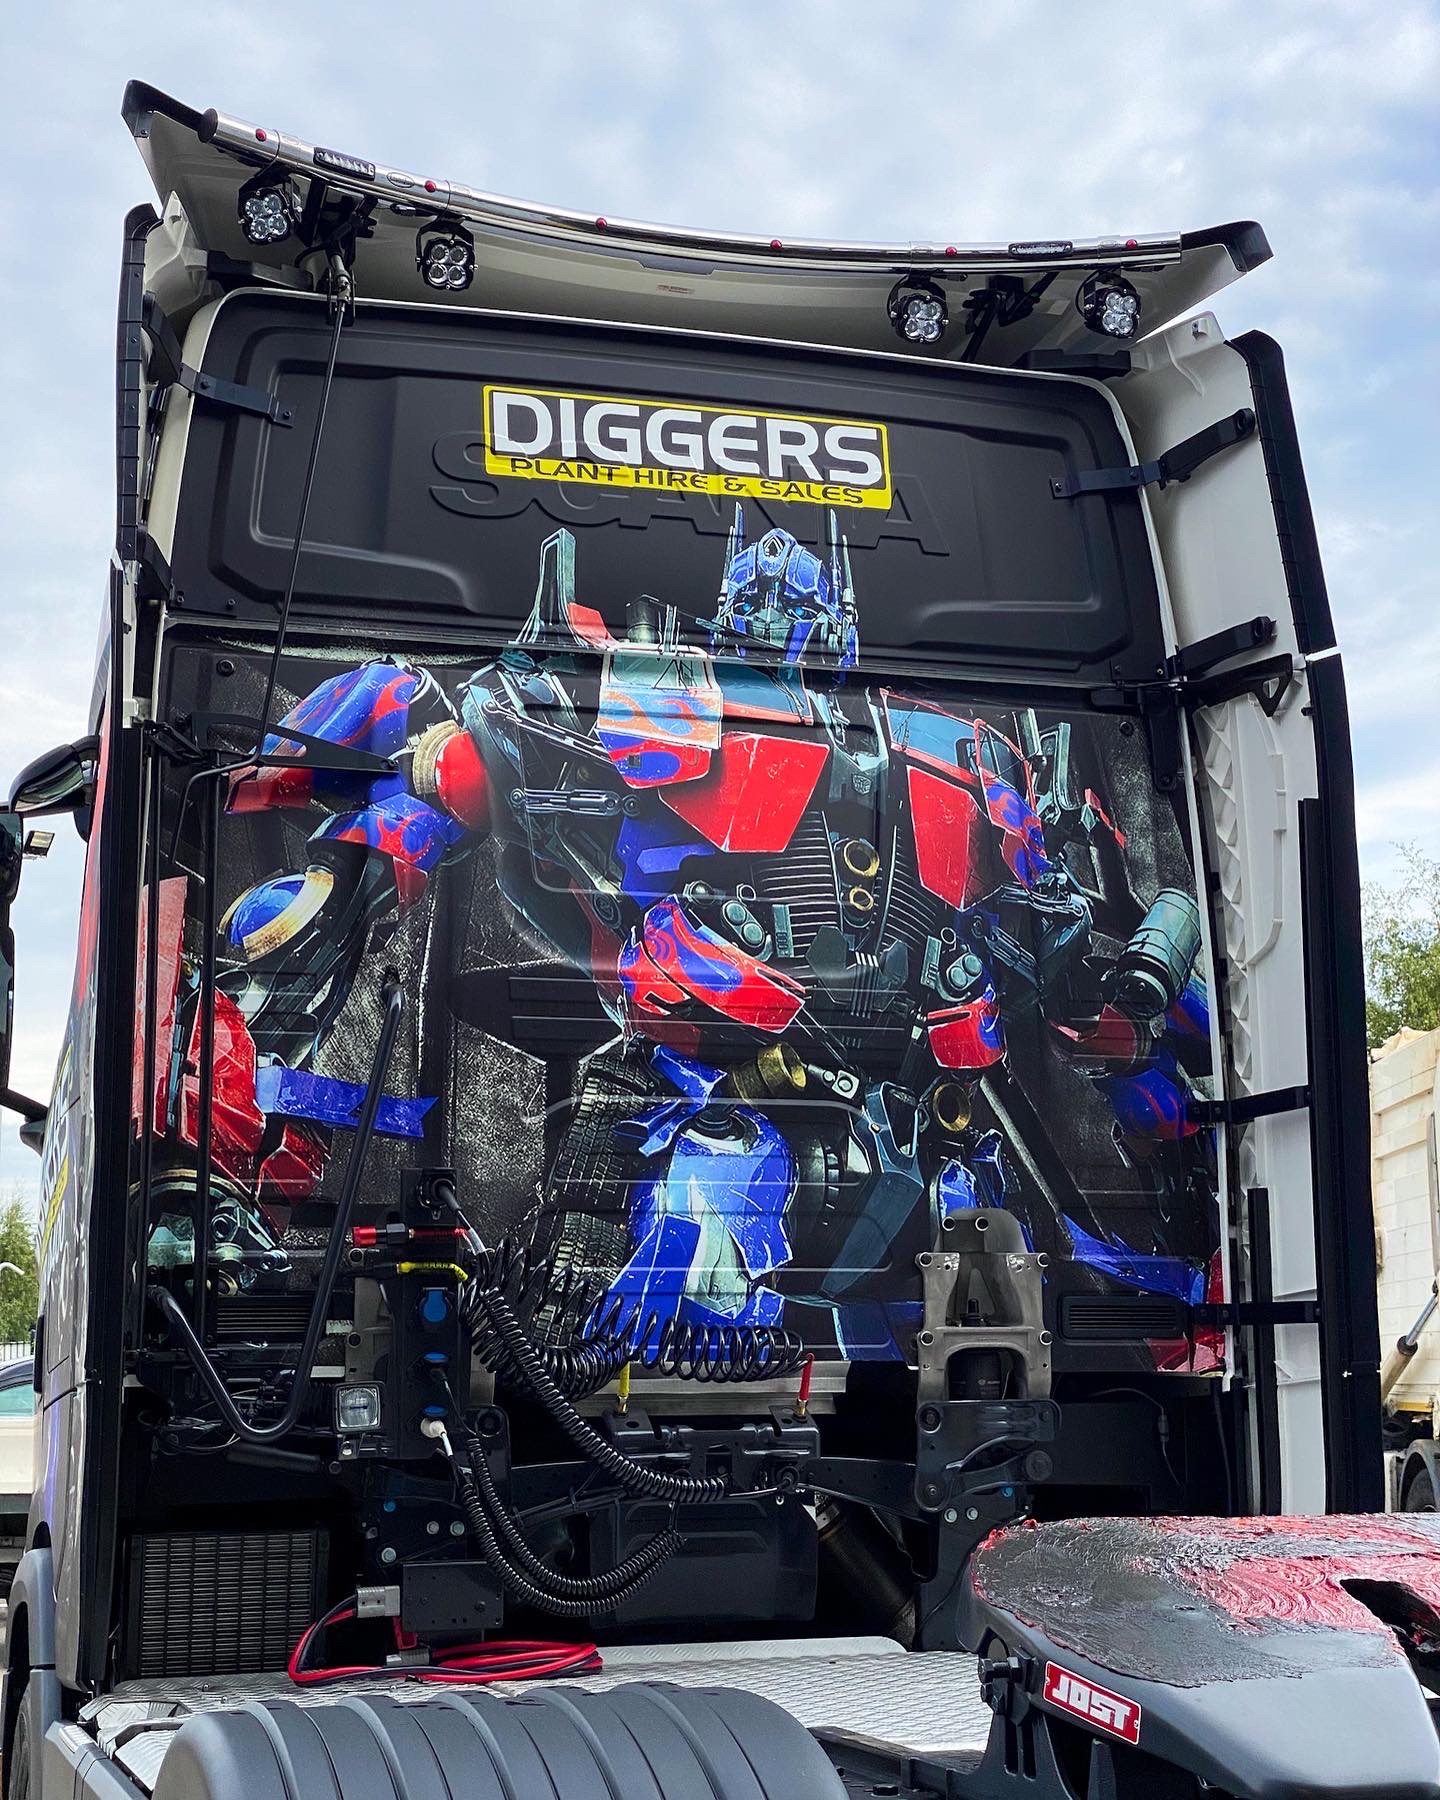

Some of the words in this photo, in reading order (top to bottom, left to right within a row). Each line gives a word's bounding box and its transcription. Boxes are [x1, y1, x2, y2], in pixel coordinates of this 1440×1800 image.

[492, 391, 883, 486] DIGGERS
[510, 457, 621, 482] PLANT
[634, 469, 708, 489] HIRE
[723, 476, 747, 492] &
[760, 480, 864, 504] SALES
[1051, 1674, 1132, 1731] JOST
